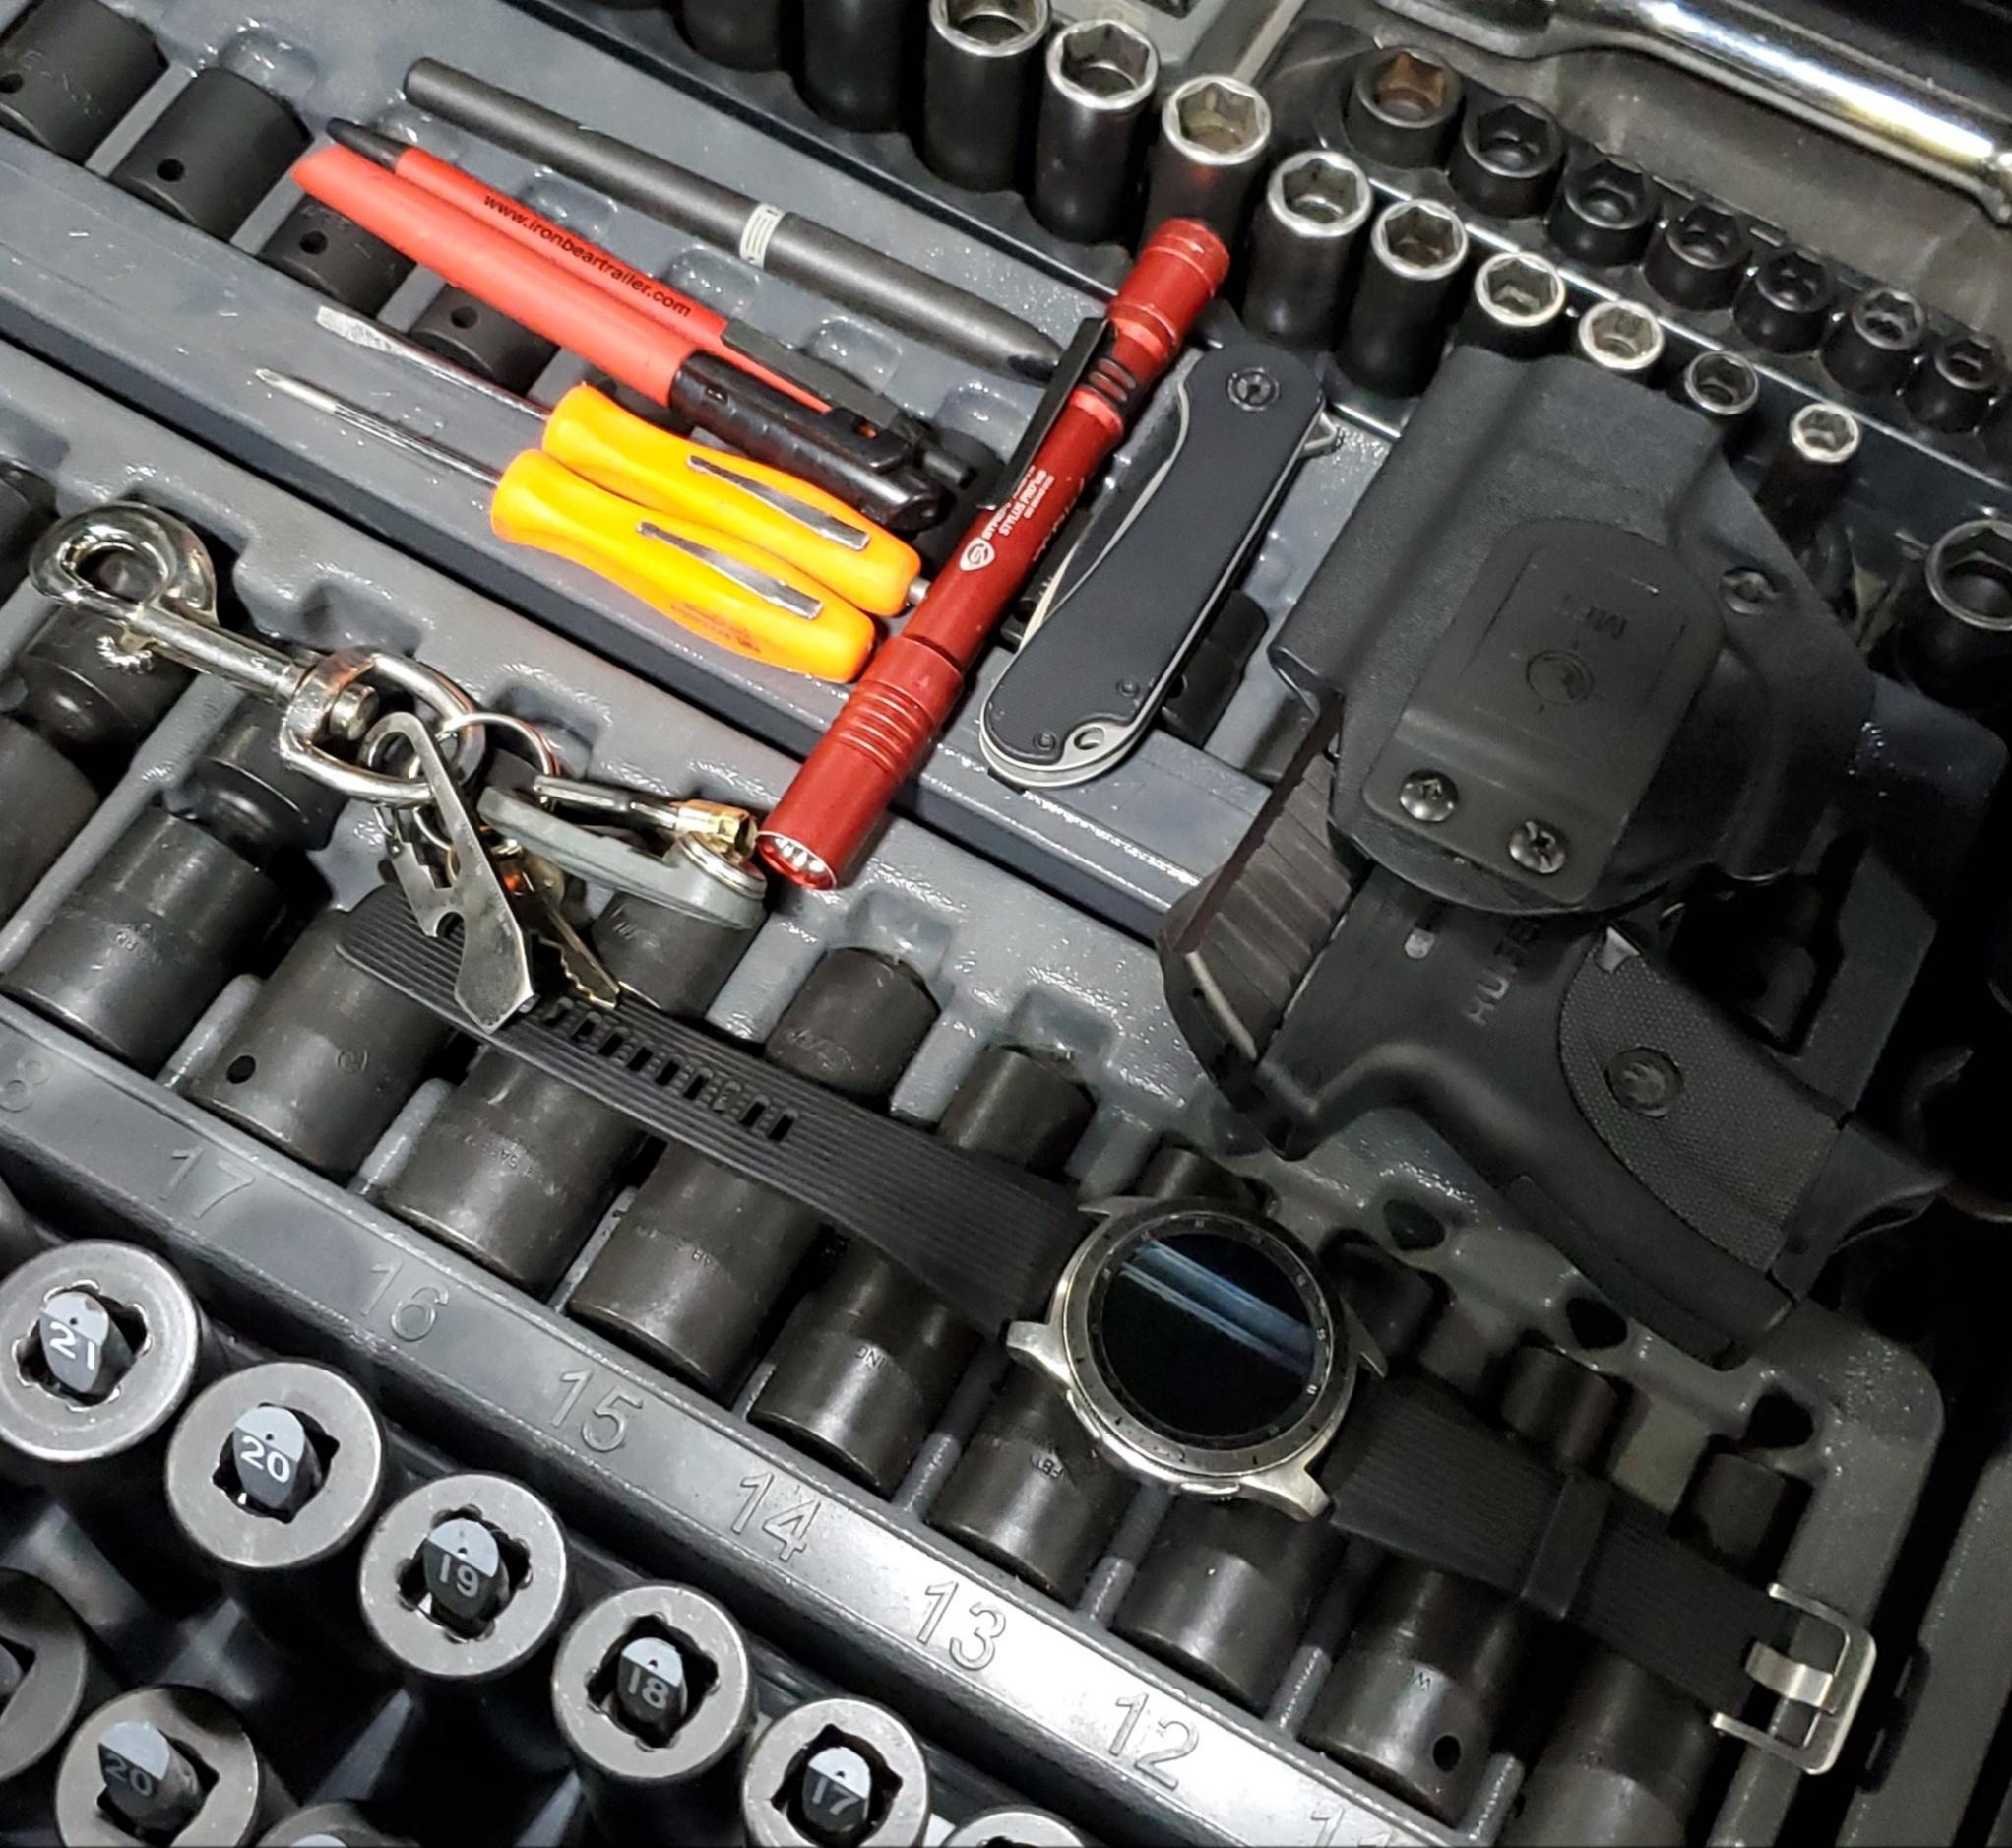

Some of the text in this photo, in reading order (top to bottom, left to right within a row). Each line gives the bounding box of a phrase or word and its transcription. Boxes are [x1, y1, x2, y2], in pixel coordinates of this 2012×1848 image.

[483, 194, 692, 317] www.ironbeartrailer.com
[160, 1146, 256, 1221] 17
[360, 1260, 449, 1342] 16
[49, 1321, 95, 1370] 21
[551, 1368, 643, 1453] 15
[240, 1435, 291, 1484] 20
[730, 1471, 821, 1563] 14
[439, 1554, 479, 1598] 19
[916, 1580, 1007, 1672] 13
[628, 1666, 669, 1710] 18
[102, 1752, 154, 1798] 20
[1108, 1692, 1200, 1792] 12
[812, 1777, 860, 1816] 17
